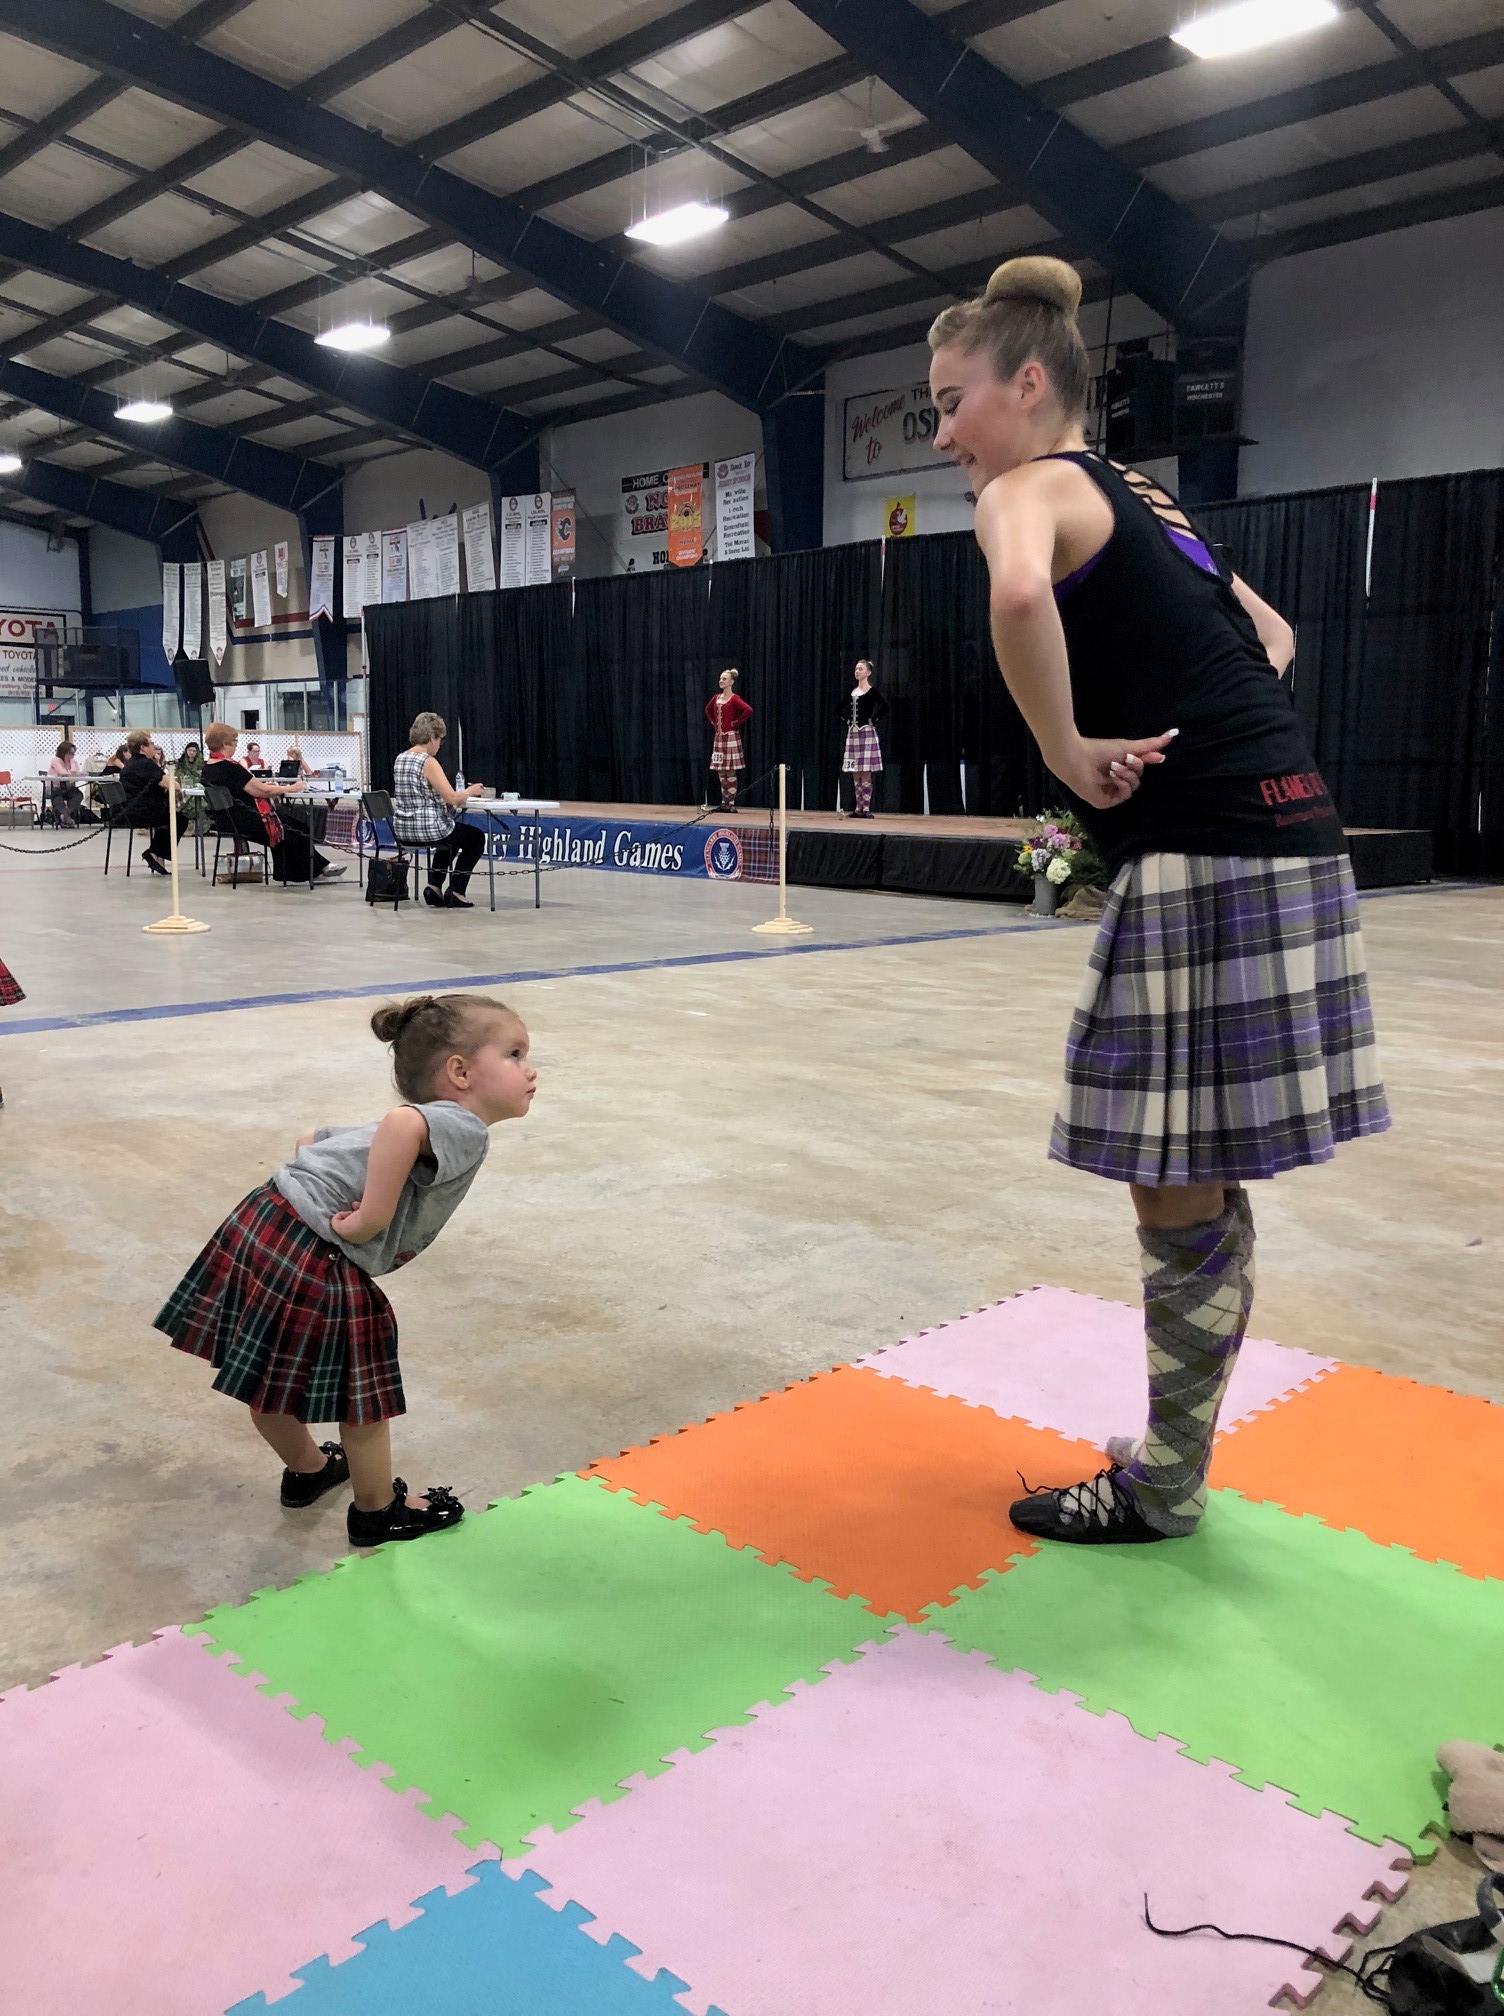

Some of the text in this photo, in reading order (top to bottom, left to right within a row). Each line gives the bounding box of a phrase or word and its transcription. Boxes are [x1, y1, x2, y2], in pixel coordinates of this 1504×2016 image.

[911, 387, 932, 400] TH
[852, 394, 906, 443] Welcome
[866, 436, 883, 465] to
[633, 475, 659, 489] HOME
[631, 514, 669, 535] BRA
[3, 649, 36, 661] TOYOT
[518, 825, 607, 865] Highland
[614, 830, 685, 871] Games
